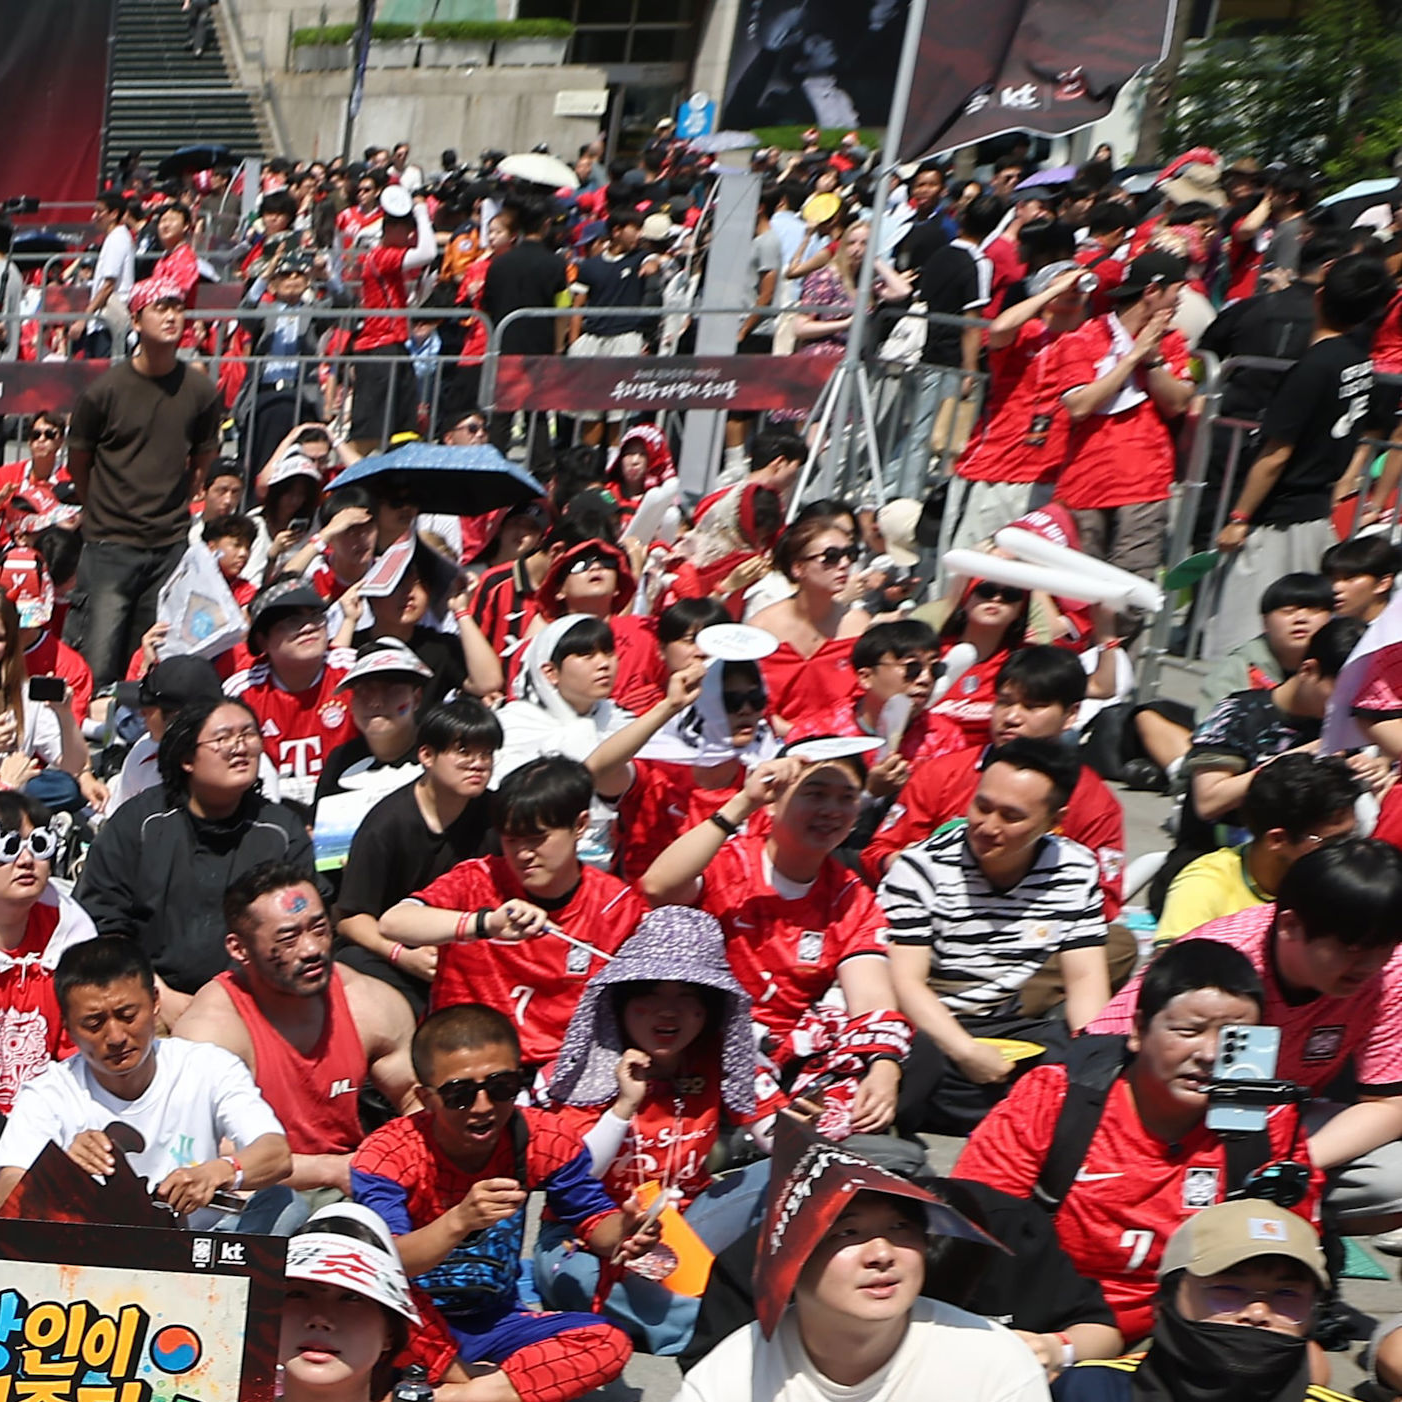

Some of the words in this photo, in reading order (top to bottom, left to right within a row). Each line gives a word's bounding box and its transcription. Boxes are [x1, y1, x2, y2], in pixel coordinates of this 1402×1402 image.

[509, 985, 535, 1027] 7
[220, 1241, 246, 1261] kt
[1118, 1229, 1155, 1269] 7
